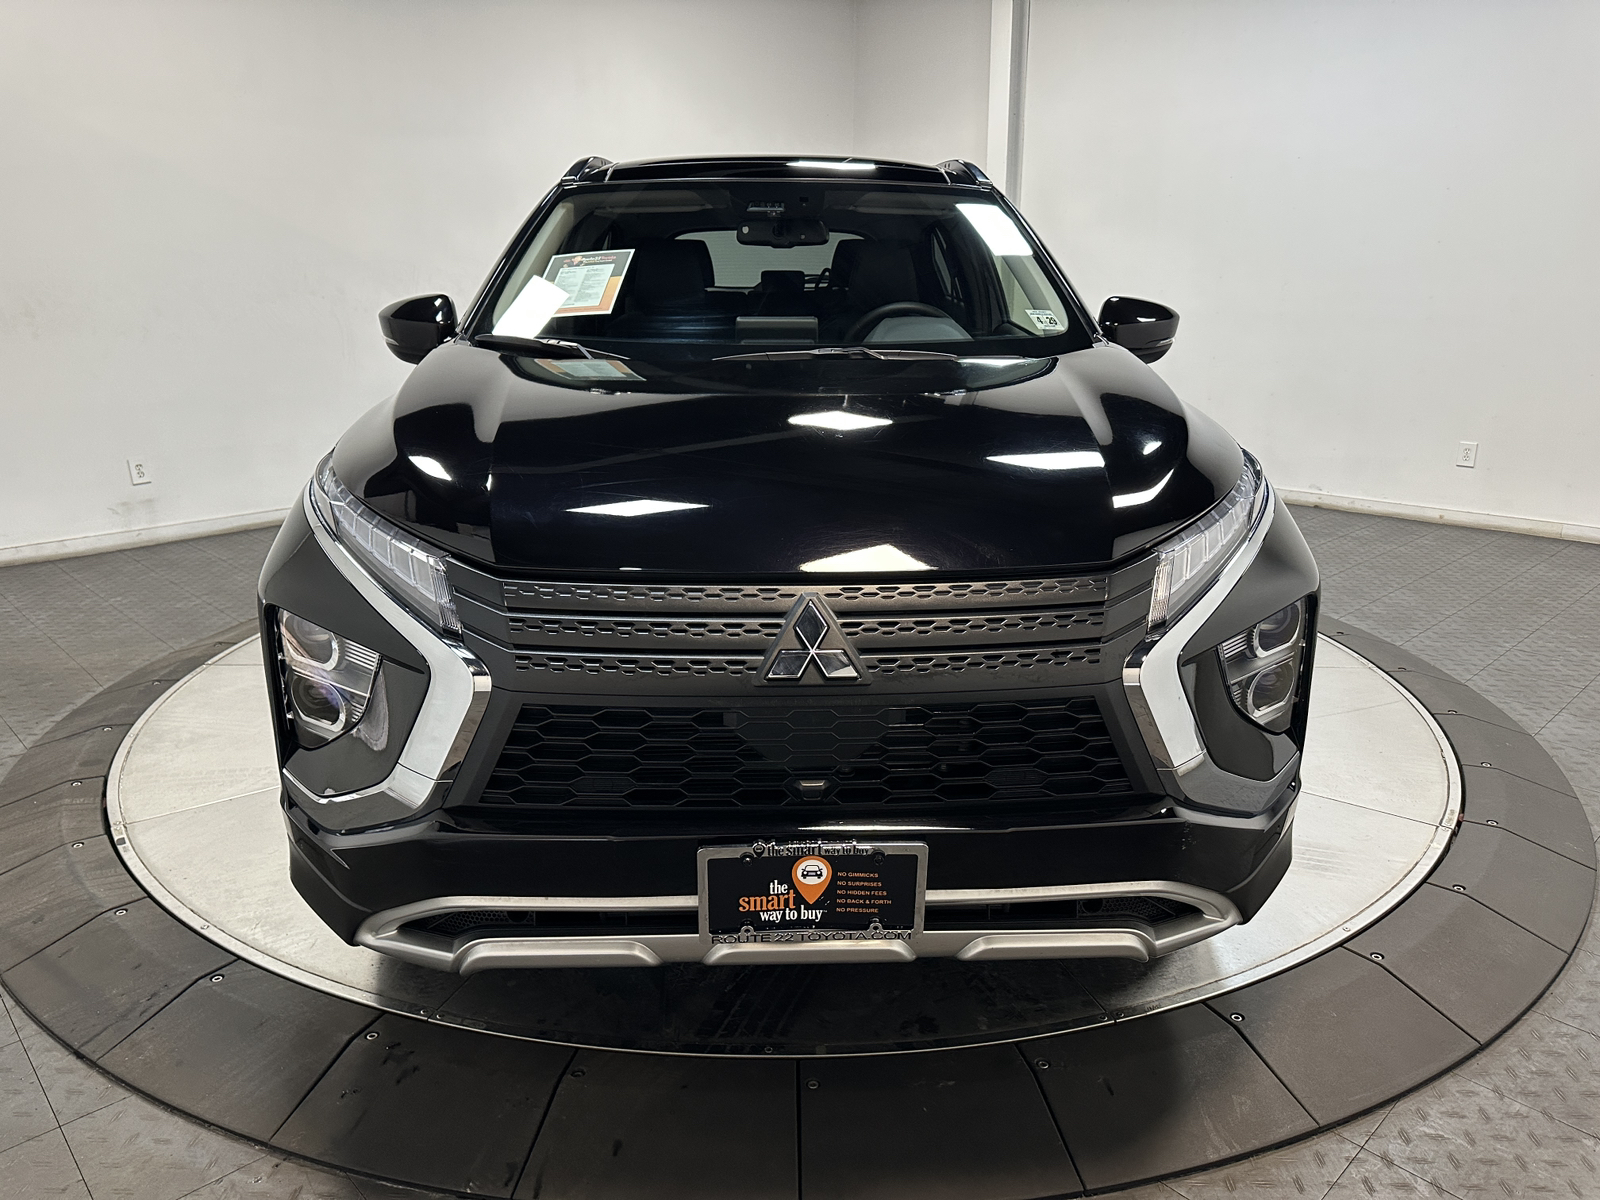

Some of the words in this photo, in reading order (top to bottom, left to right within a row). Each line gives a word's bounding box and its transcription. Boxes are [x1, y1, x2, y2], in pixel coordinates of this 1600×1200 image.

[769, 879, 788, 895] the
[739, 889, 796, 912] smart
[760, 910, 784, 923] way
[785, 907, 798, 920] to
[800, 904, 823, 922] buy
